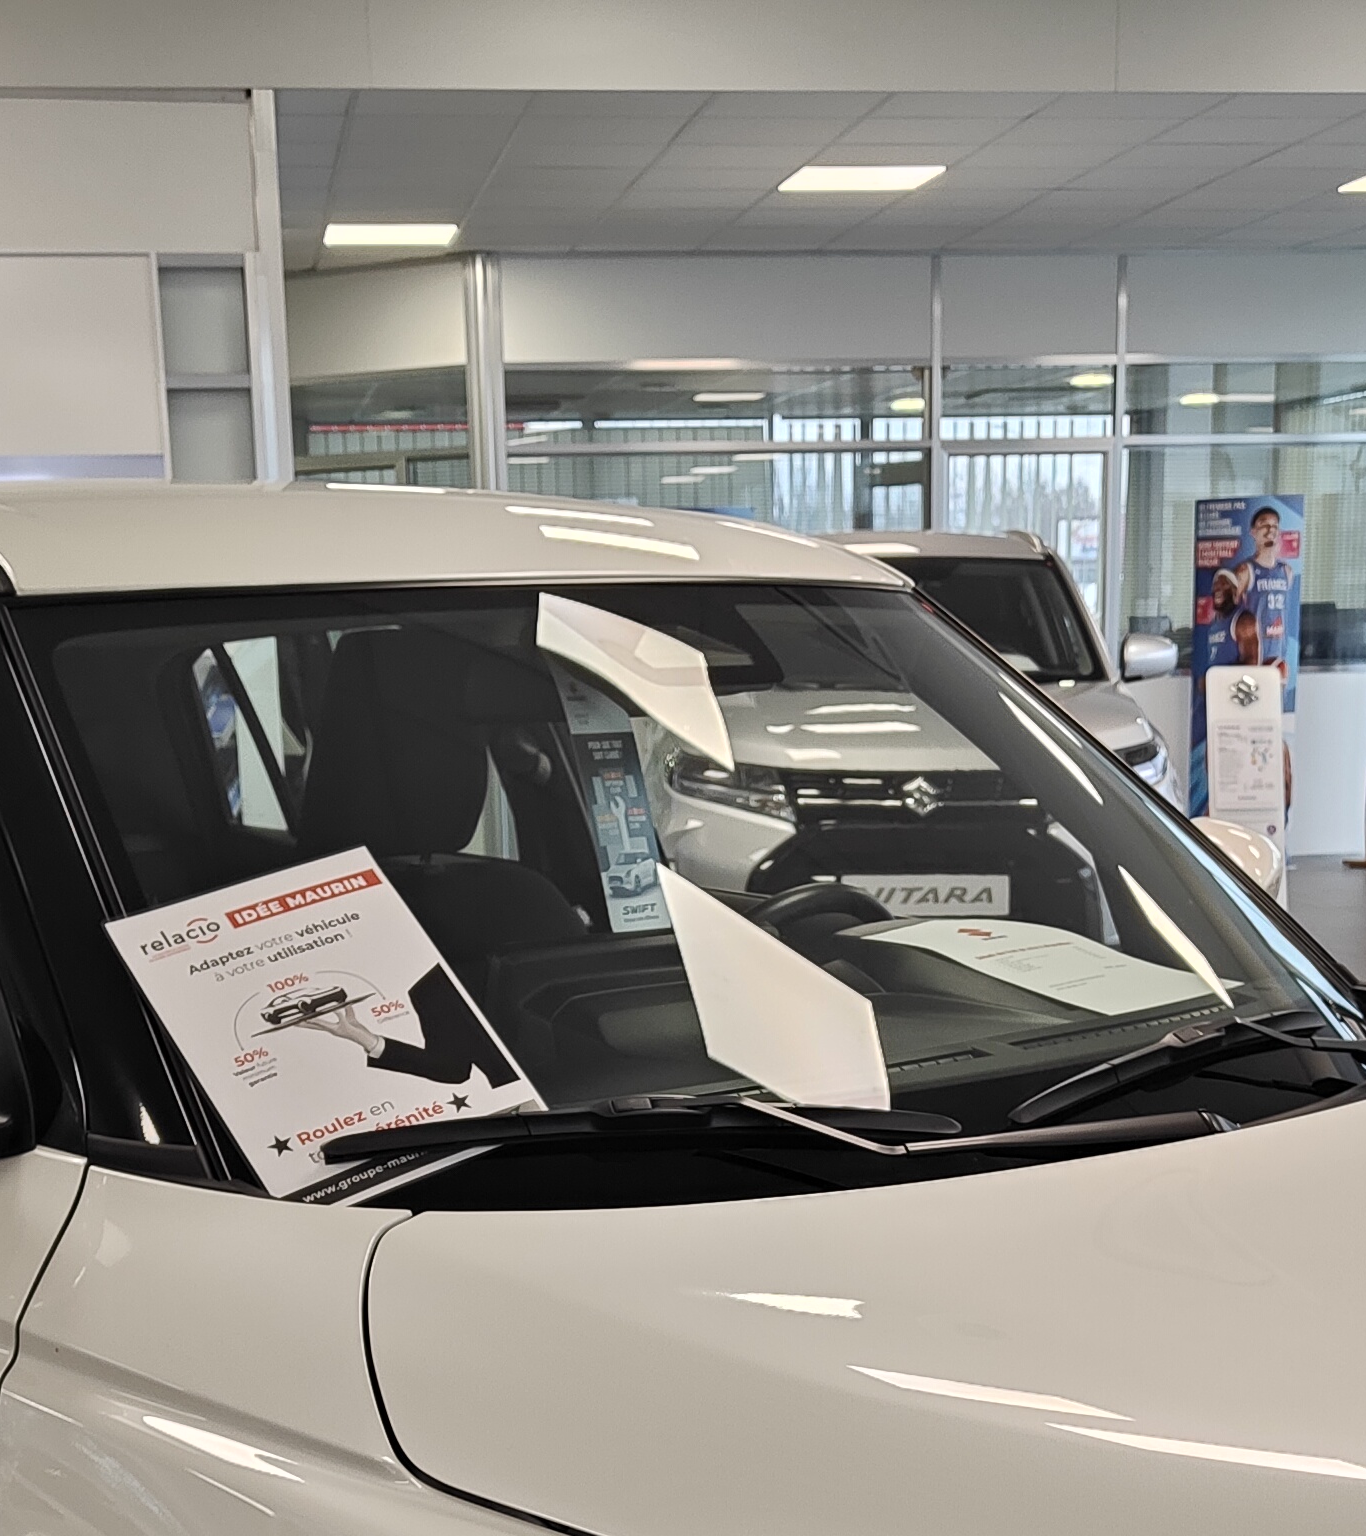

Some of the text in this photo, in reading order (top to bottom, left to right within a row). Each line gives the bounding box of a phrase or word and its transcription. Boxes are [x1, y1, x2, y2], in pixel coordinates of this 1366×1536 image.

[233, 875, 367, 926] IDÉE MAURIN
[622, 902, 657, 916] SWIFT
[139, 921, 221, 956] relacio
[189, 944, 255, 976] Adaptez
[253, 933, 294, 952] votre
[294, 911, 361, 938] véhicule
[214, 971, 225, 983] à
[225, 958, 266, 979] votre
[267, 932, 346, 964] utilisation
[266, 973, 309, 994] 100%
[370, 1000, 405, 1018] 50%
[234, 1047, 269, 1068] 50%
[296, 1100, 395, 1146] Roulez en
[375, 1101, 444, 1131] érénité
